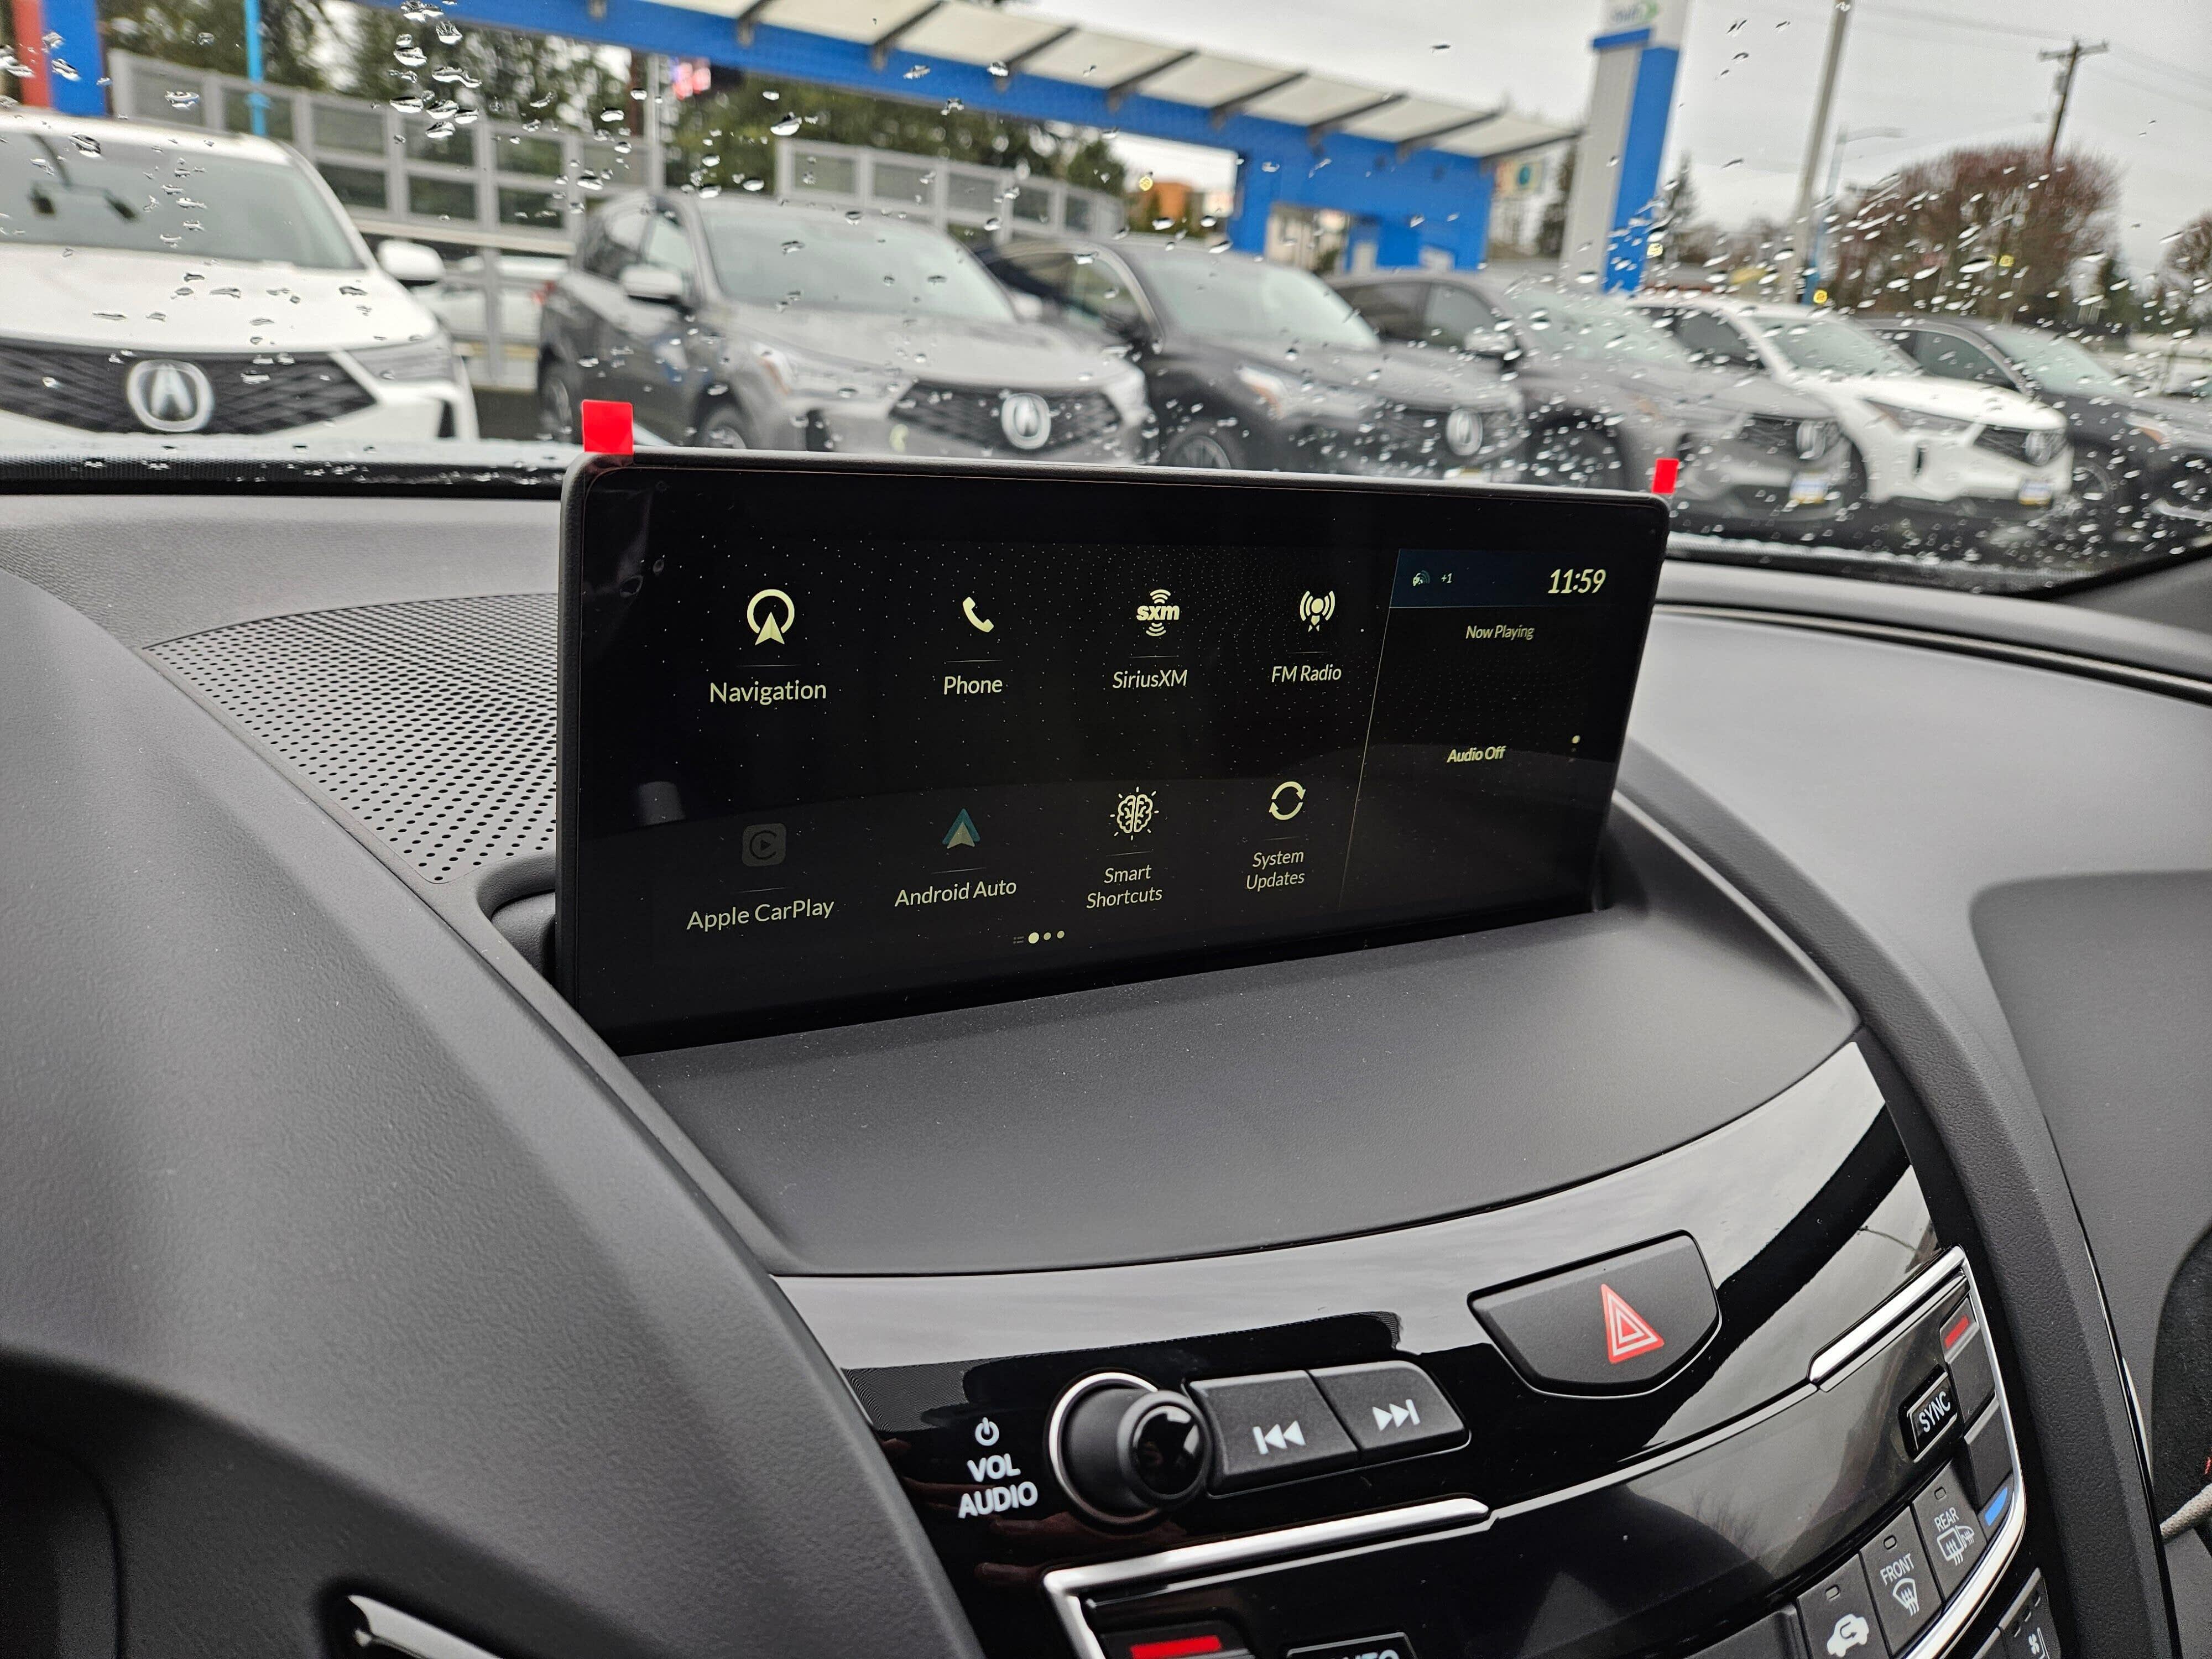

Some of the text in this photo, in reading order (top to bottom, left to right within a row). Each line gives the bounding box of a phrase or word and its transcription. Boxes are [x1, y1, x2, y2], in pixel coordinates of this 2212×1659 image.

[1441, 573, 1452, 583] +1
[1548, 569, 1606, 593] 11:59
[1136, 605, 1180, 620] sxm
[1466, 624, 1535, 640] Now Playing
[1113, 670, 1187, 688] SiriusXM
[1271, 664, 1342, 682] FM Radio
[709, 681, 827, 705] Navigation
[943, 676, 1003, 695] Phone
[1447, 745, 1506, 763] Audio Off
[1252, 851, 1304, 870] System
[1104, 864, 1151, 883] Smart
[1246, 871, 1305, 891] Updates
[894, 880, 1016, 907] Android Auto
[1086, 887, 1162, 909] Shortcuts
[686, 899, 834, 932] Apple CarPlay
[1919, 1391, 1950, 1432] SYNC
[967, 1453, 1021, 1482] VOL
[958, 1481, 1038, 1519] AUDIO
[1934, 1507, 1959, 1531] REAR
[1880, 1553, 1915, 1585] FRONT
